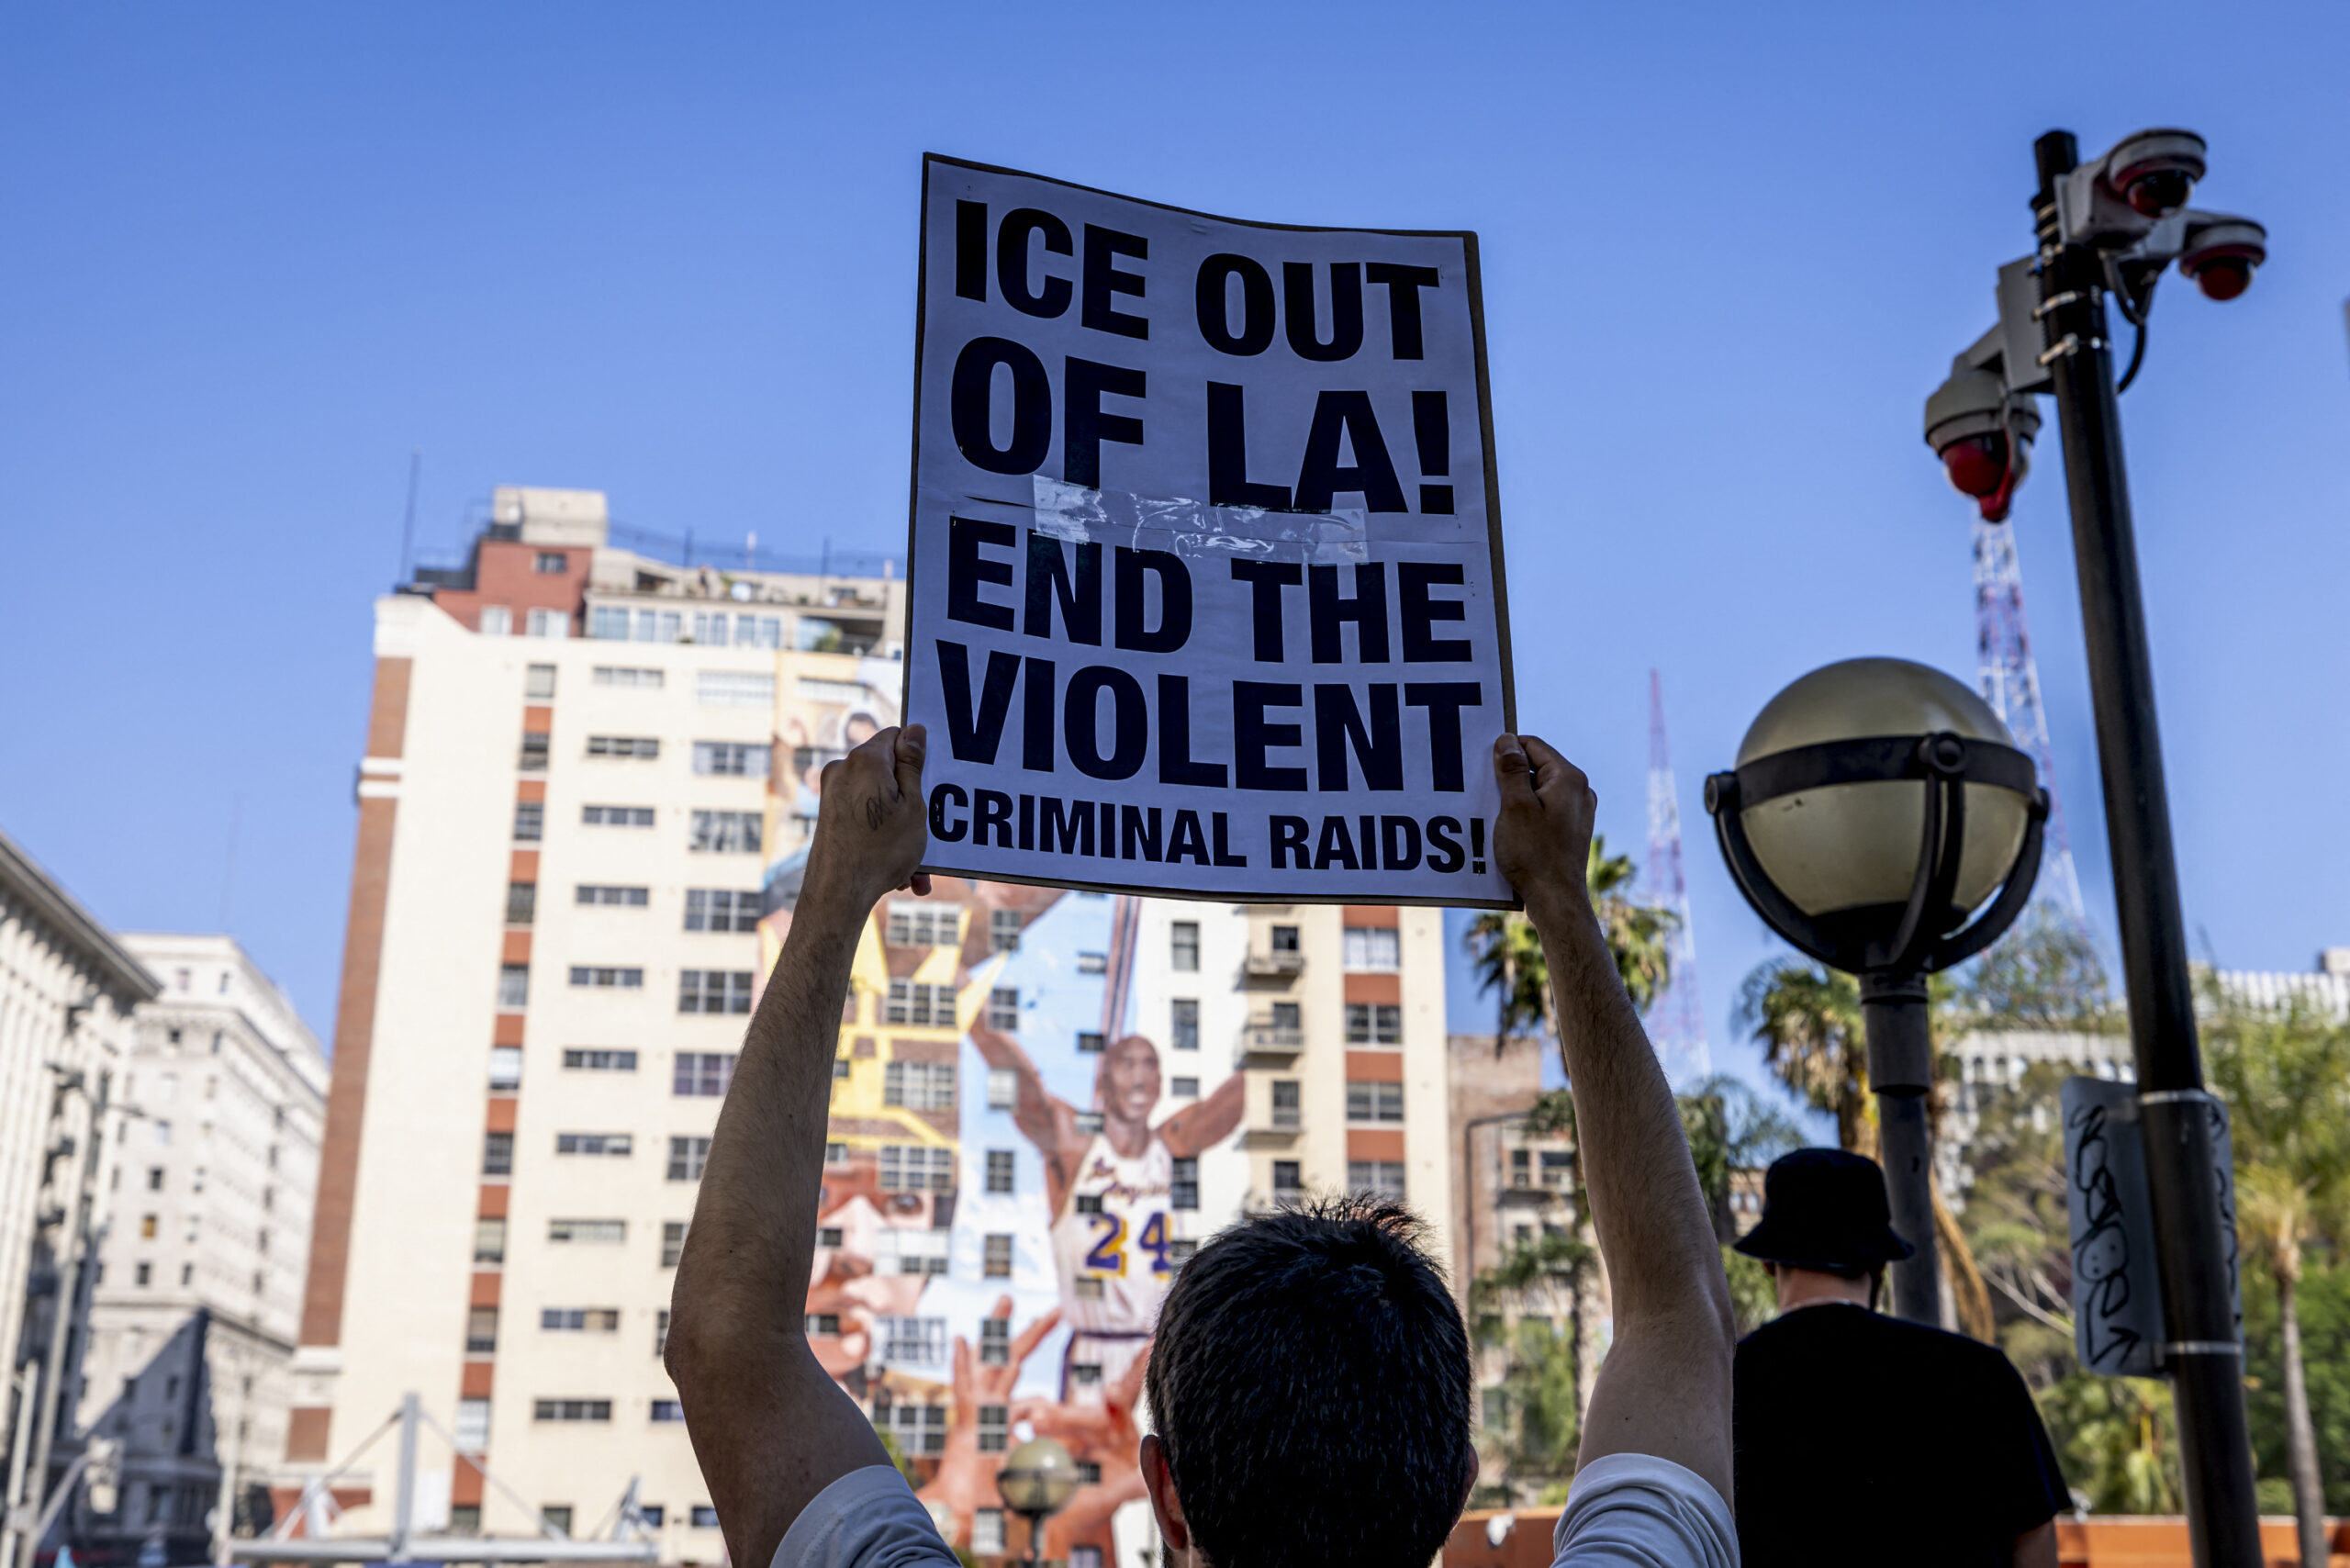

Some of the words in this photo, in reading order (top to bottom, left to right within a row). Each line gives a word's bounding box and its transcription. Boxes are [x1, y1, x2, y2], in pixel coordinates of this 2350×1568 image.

[955, 198, 1149, 342] ICE
[1195, 252, 1440, 362] OUT
[950, 336, 1147, 492] OF
[1206, 380, 1456, 515] LA!
[946, 515, 1193, 655] END
[1230, 557, 1473, 664] THE
[935, 639, 1483, 793] VIOLENT
[928, 783, 1248, 868] CRIMINAL
[1270, 814, 1486, 876] RAIDS!
[1085, 1211, 1172, 1279] 24
